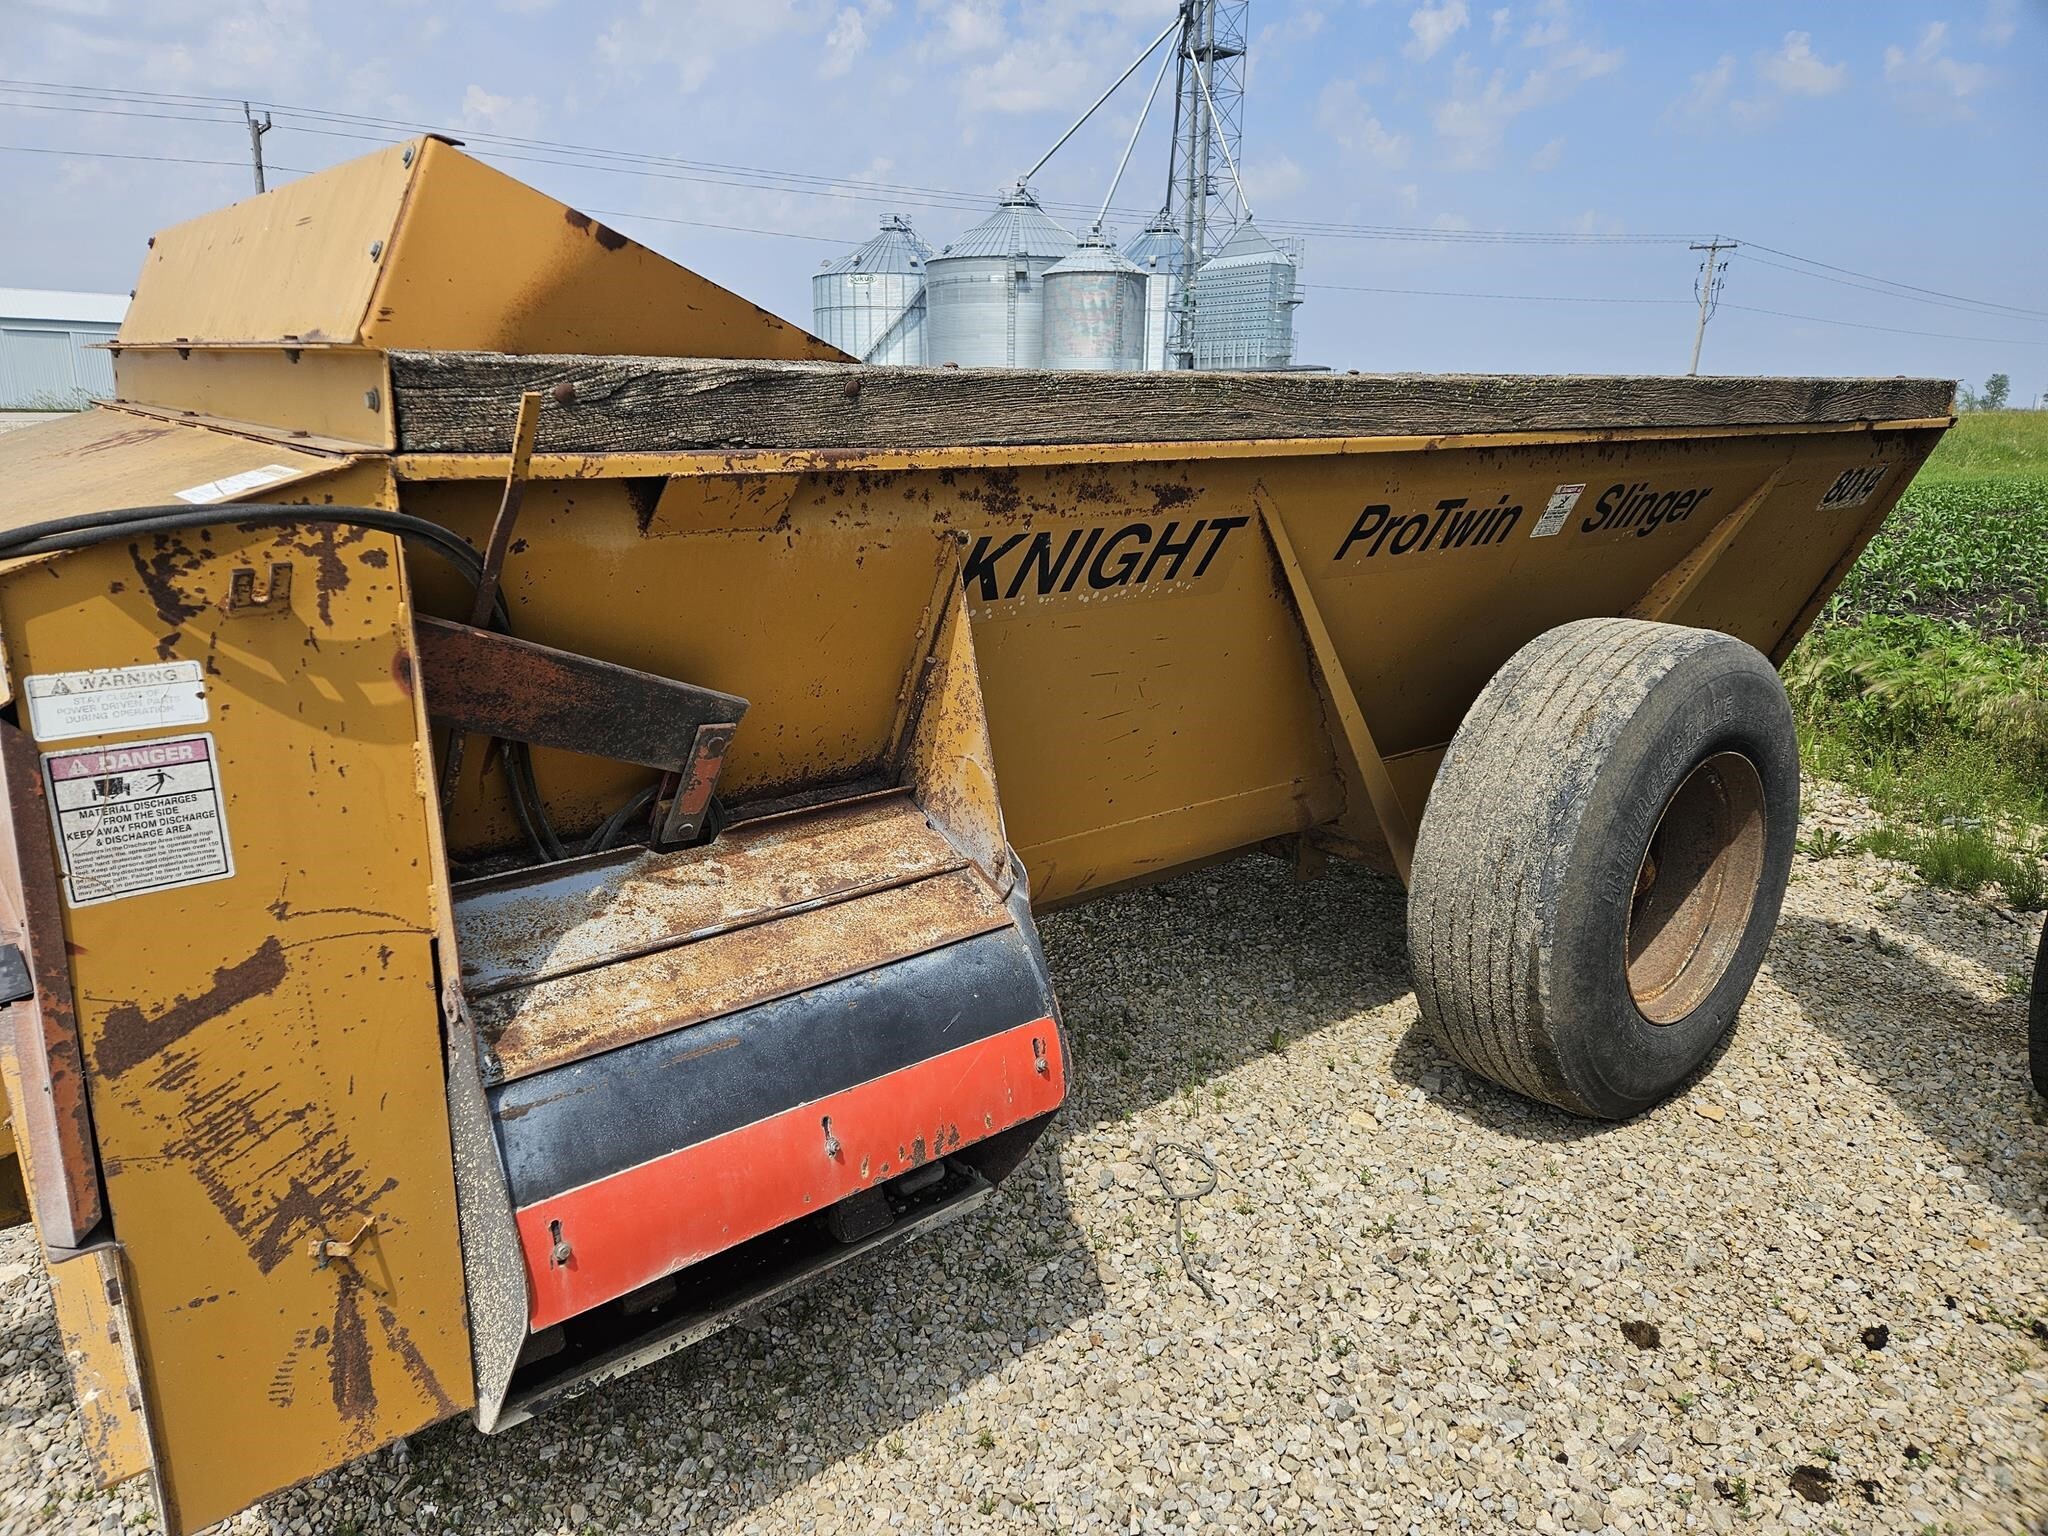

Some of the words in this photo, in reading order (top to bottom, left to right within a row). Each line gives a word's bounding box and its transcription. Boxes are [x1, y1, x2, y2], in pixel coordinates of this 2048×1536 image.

[1333, 495, 1523, 560] ProTwin
[1581, 482, 1713, 538] Slinger
[963, 516, 1249, 601] KNIGHT
[79, 669, 178, 689] WARNING
[57, 704, 97, 716] POWER
[101, 699, 142, 711] DRIVEN
[73, 696, 100, 705] STAY
[66, 712, 108, 723] DURING
[98, 745, 193, 771] DANGER
[78, 804, 132, 819] MATERIAL
[133, 794, 197, 810] DISCHARGES
[103, 813, 132, 825] FROM
[135, 810, 154, 820] THE
[155, 806, 179, 817] SIDE
[66, 829, 95, 841] KEEP
[96, 824, 126, 836] AWAY
[128, 819, 157, 831] FROM
[159, 810, 215, 826] DISCHARGE
[95, 838, 102, 846] &
[105, 828, 163, 845] DISCHARGE
[165, 823, 192, 835] AREA
[123, 839, 157, 849] Discharge
